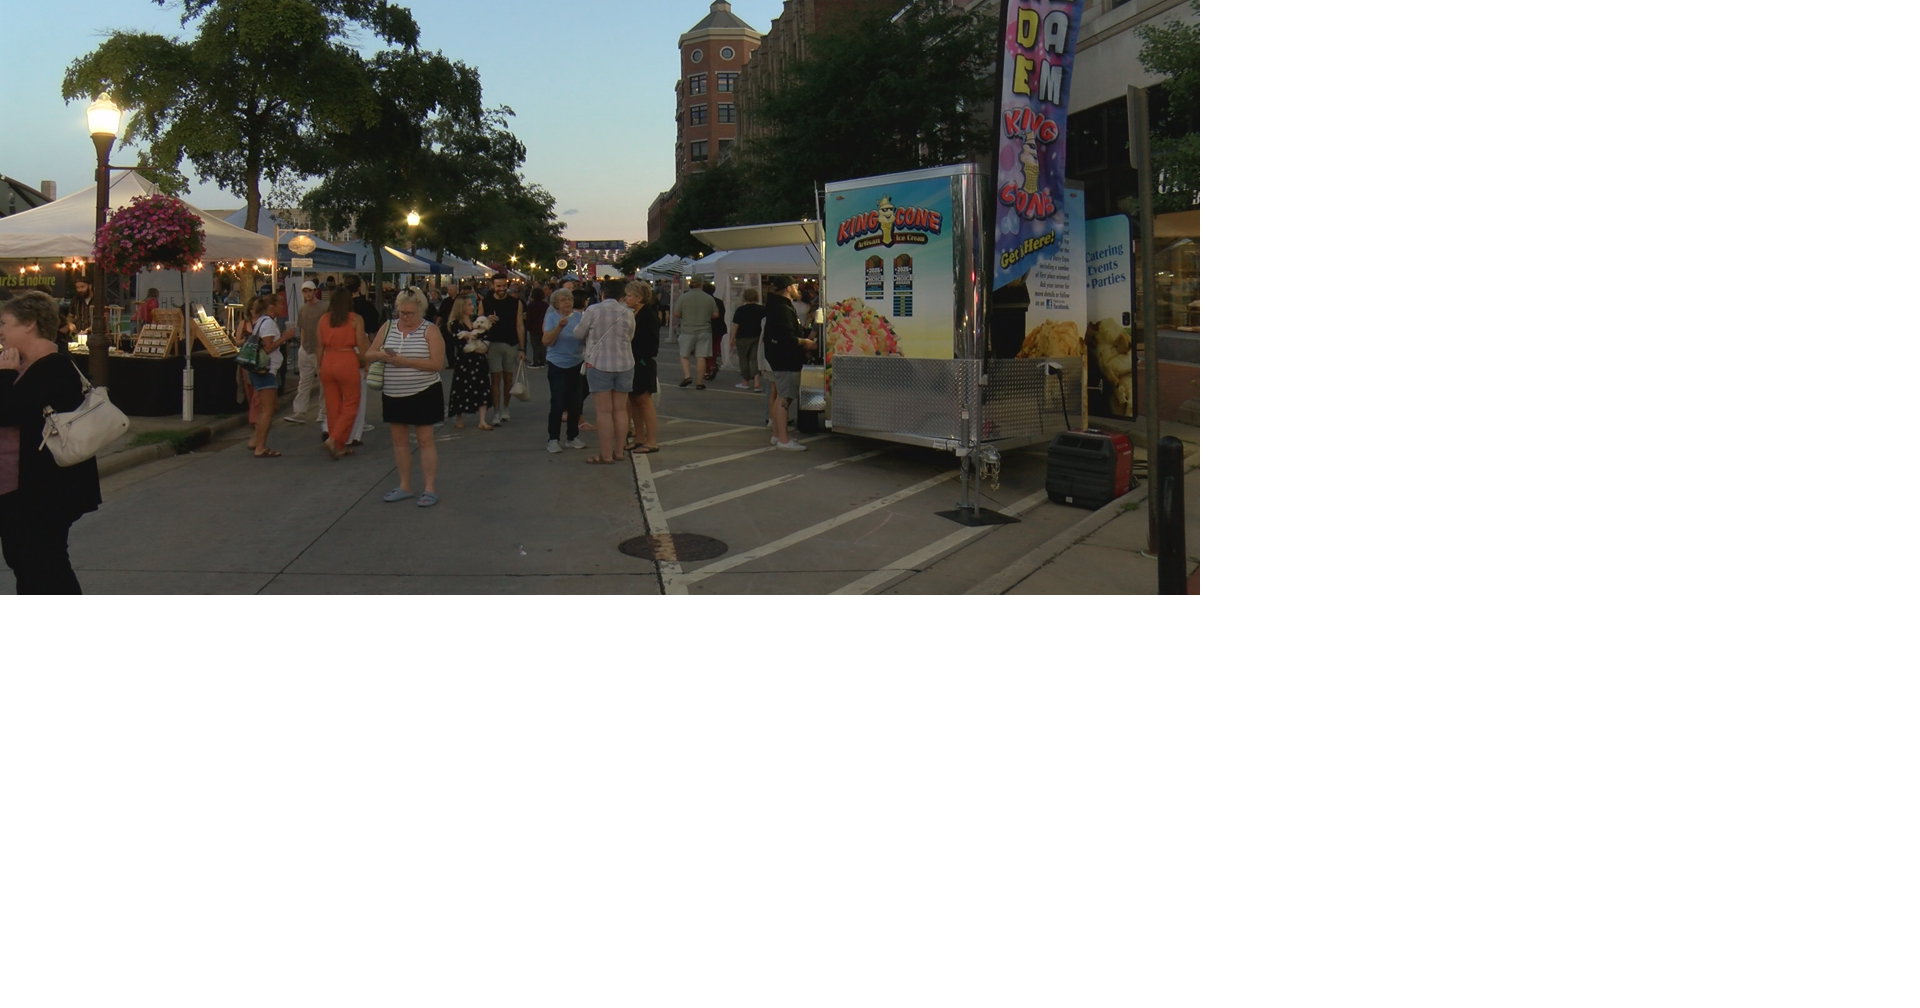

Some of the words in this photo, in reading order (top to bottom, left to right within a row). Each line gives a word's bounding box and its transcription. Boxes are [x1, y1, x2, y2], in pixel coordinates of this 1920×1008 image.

[1004, 107, 1057, 143] KING
[1000, 183, 1055, 219] CONE
[838, 210, 878, 245] KING
[895, 207, 942, 234] CONE
[858, 238, 881, 248] Artisan
[896, 234, 906, 242] Ice
[907, 234, 925, 242] Cream
[1001, 250, 1018, 268] Get
[1024, 231, 1054, 253] Here!
[1086, 244, 1124, 263] Catering
[1040, 263, 1054, 271] including
[1088, 260, 1118, 276] Events
[0, 274, 17, 286] rts
[27, 274, 56, 286] nature
[1091, 273, 1126, 288] Parties
